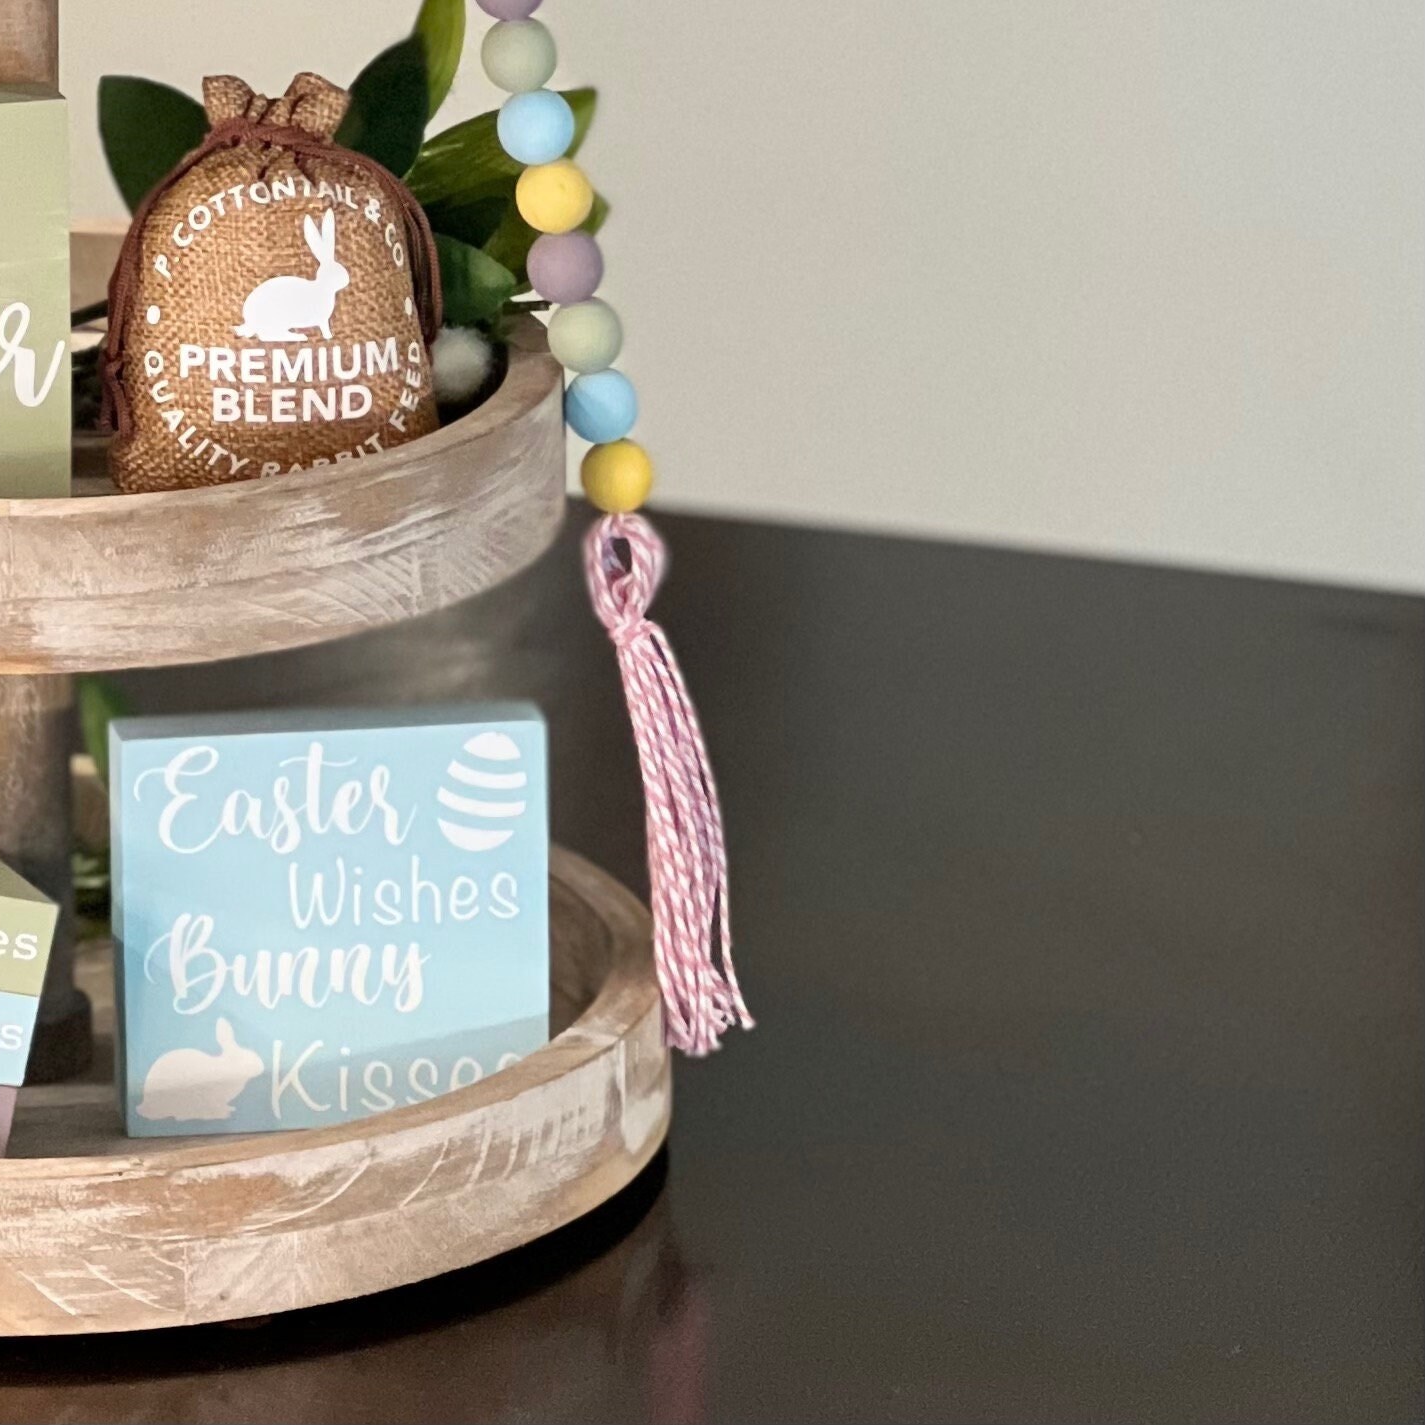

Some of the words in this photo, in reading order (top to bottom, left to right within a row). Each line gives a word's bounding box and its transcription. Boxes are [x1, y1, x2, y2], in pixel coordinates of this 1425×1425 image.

[172, 176, 360, 248] COTTONTAIL
[364, 195, 383, 226] &
[179, 337, 399, 384] PREMIUM
[143, 350, 250, 476] QUALITY
[388, 340, 422, 434] FEED
[212, 384, 373, 424] BLEND
[133, 740, 418, 855] Easter
[288, 855, 520, 929] Wishes
[144, 912, 433, 1016] Bunny
